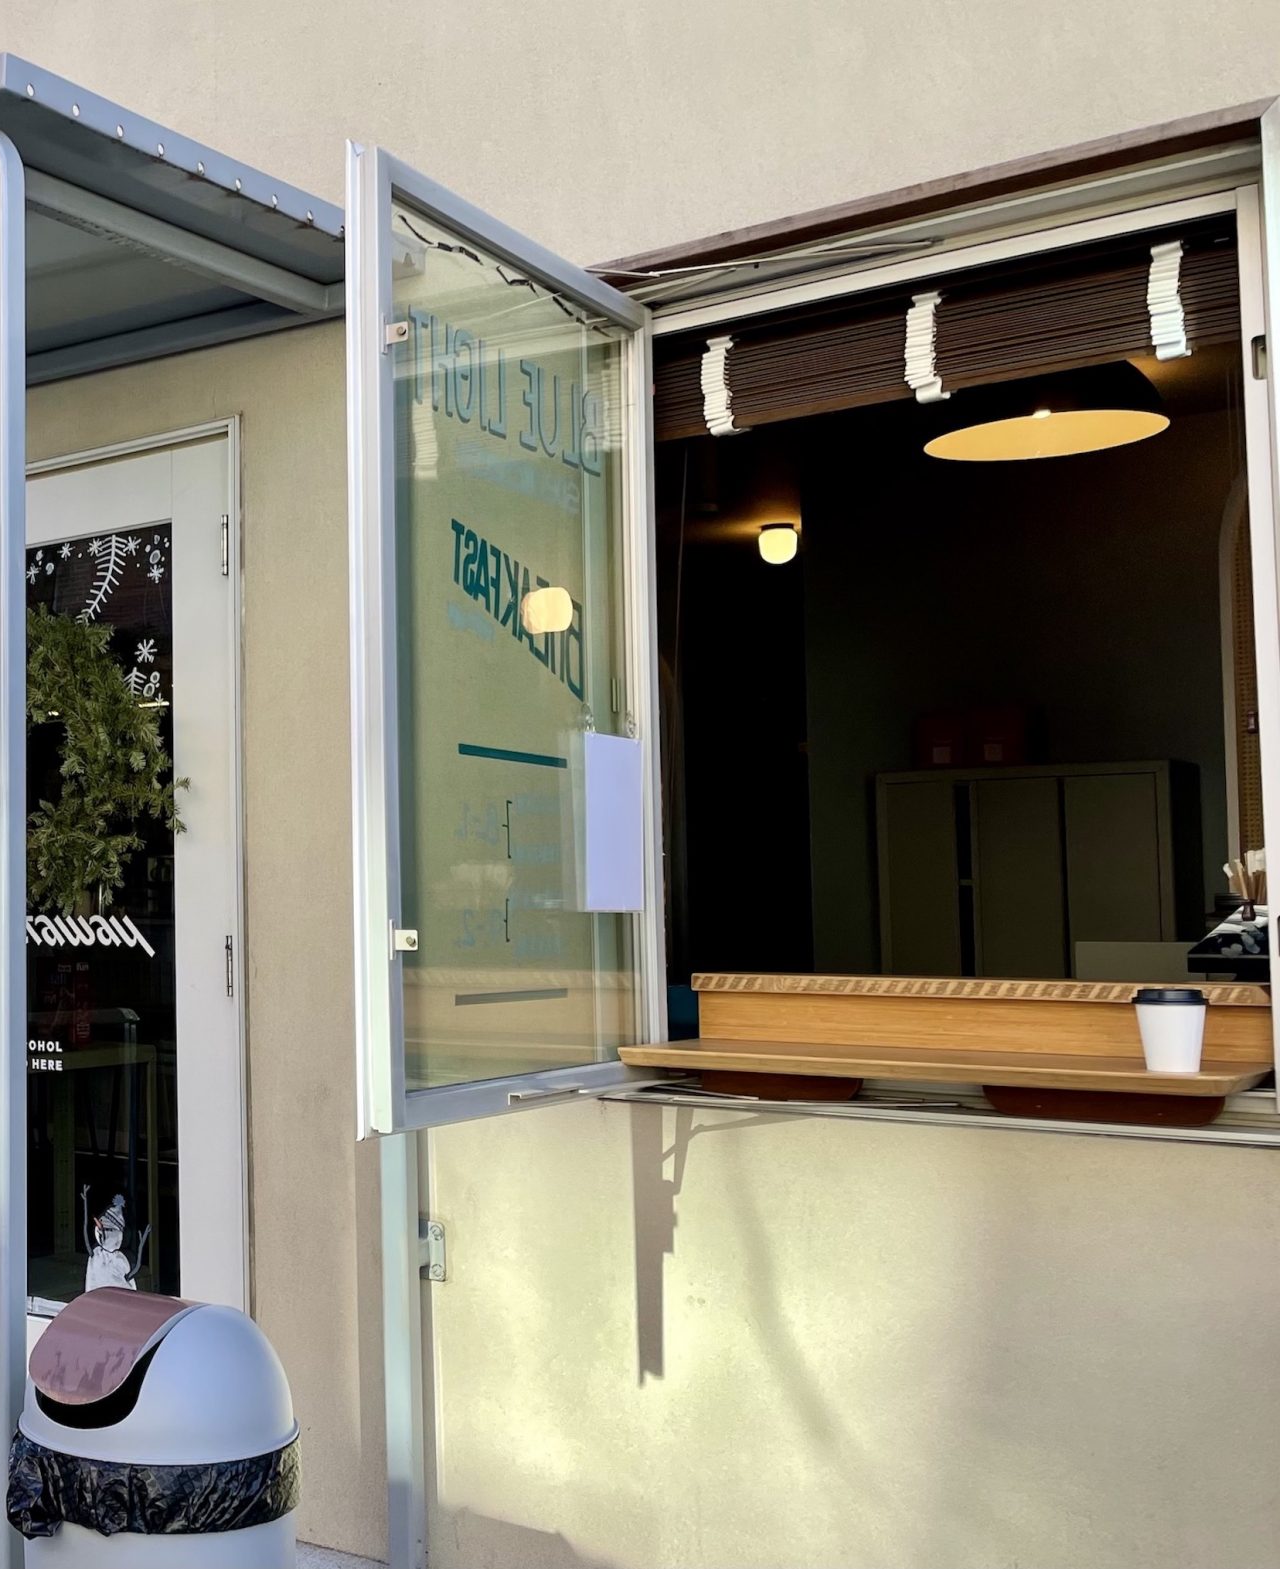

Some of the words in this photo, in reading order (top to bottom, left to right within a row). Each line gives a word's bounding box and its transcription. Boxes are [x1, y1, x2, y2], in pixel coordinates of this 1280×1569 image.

[26, 914, 156, 958] raway
[27, 1040, 63, 1052] OHOL
[31, 1058, 63, 1071] HERE
